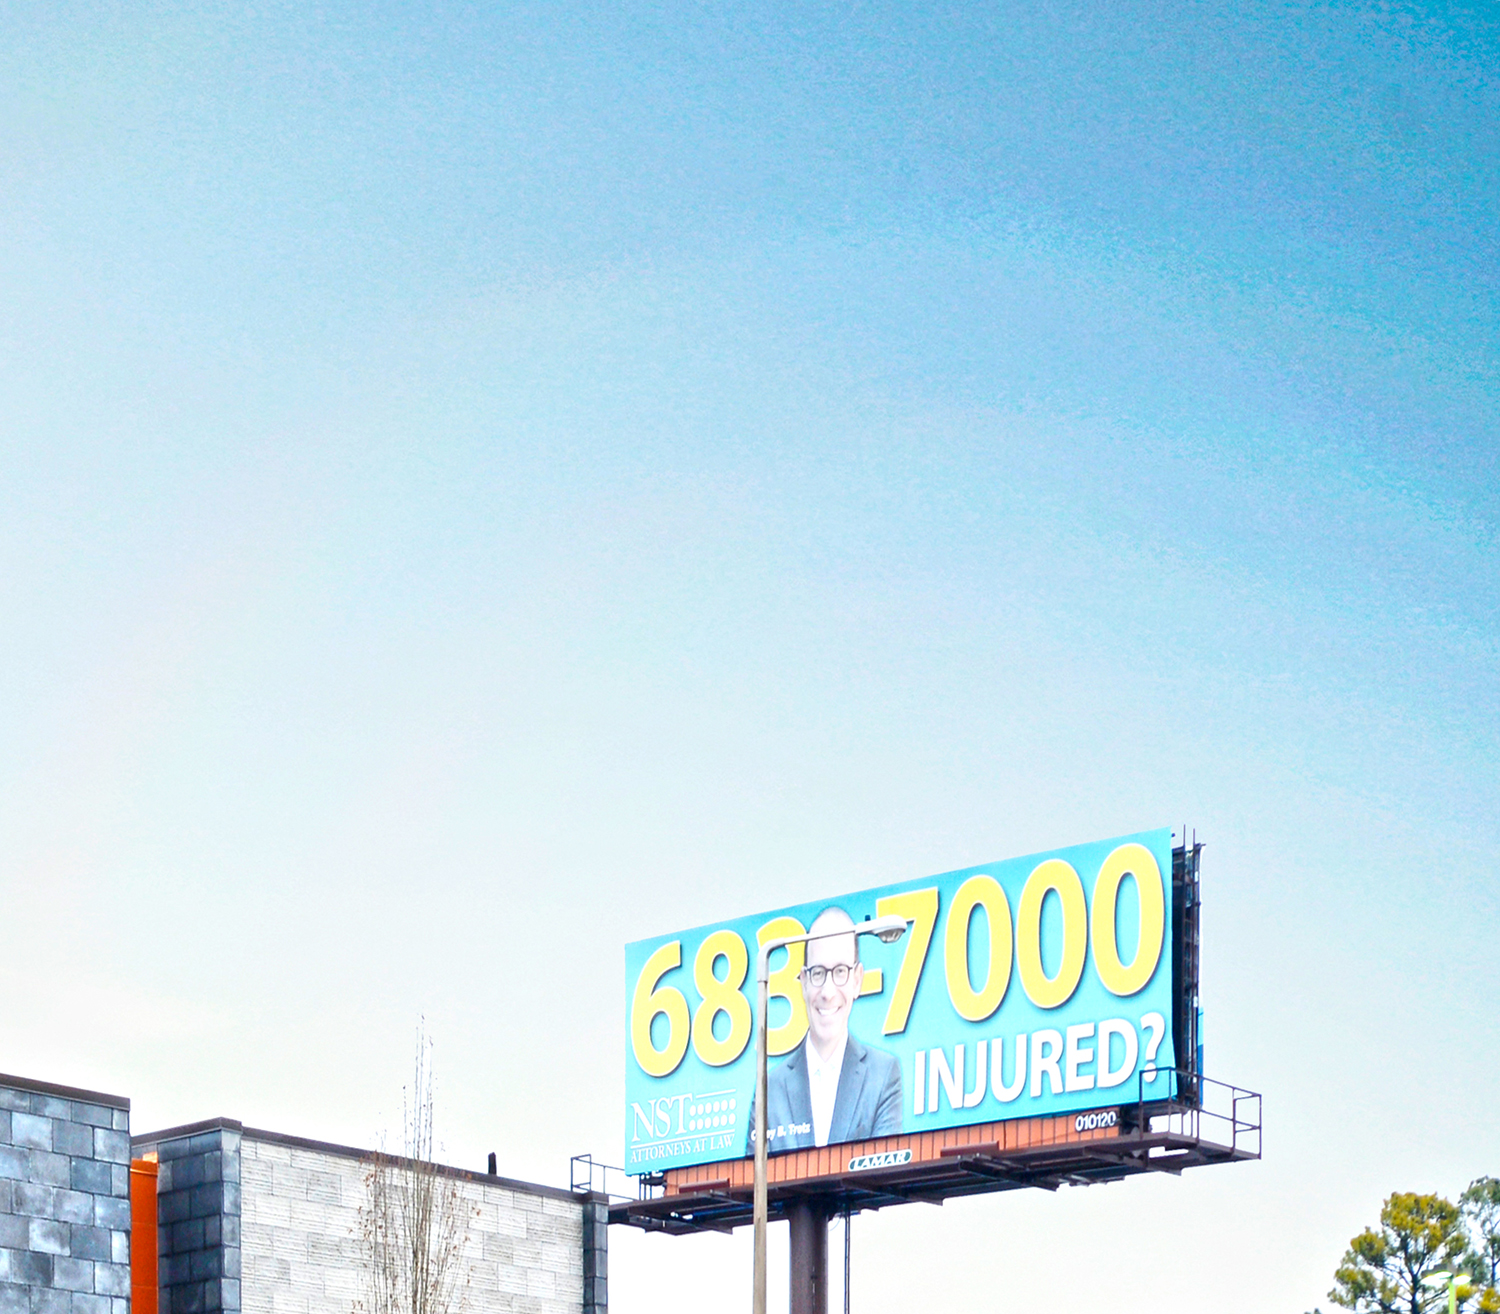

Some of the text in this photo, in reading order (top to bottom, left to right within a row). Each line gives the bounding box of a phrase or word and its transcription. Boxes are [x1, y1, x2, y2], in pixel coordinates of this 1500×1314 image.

[914, 1012, 1166, 1115] INJURED?
[630, 1093, 692, 1142] NST
[1074, 1110, 1117, 1132] 010120
[630, 1134, 735, 1164] ATTORNEYS AT LAW
[853, 1152, 906, 1171] LAMAR
